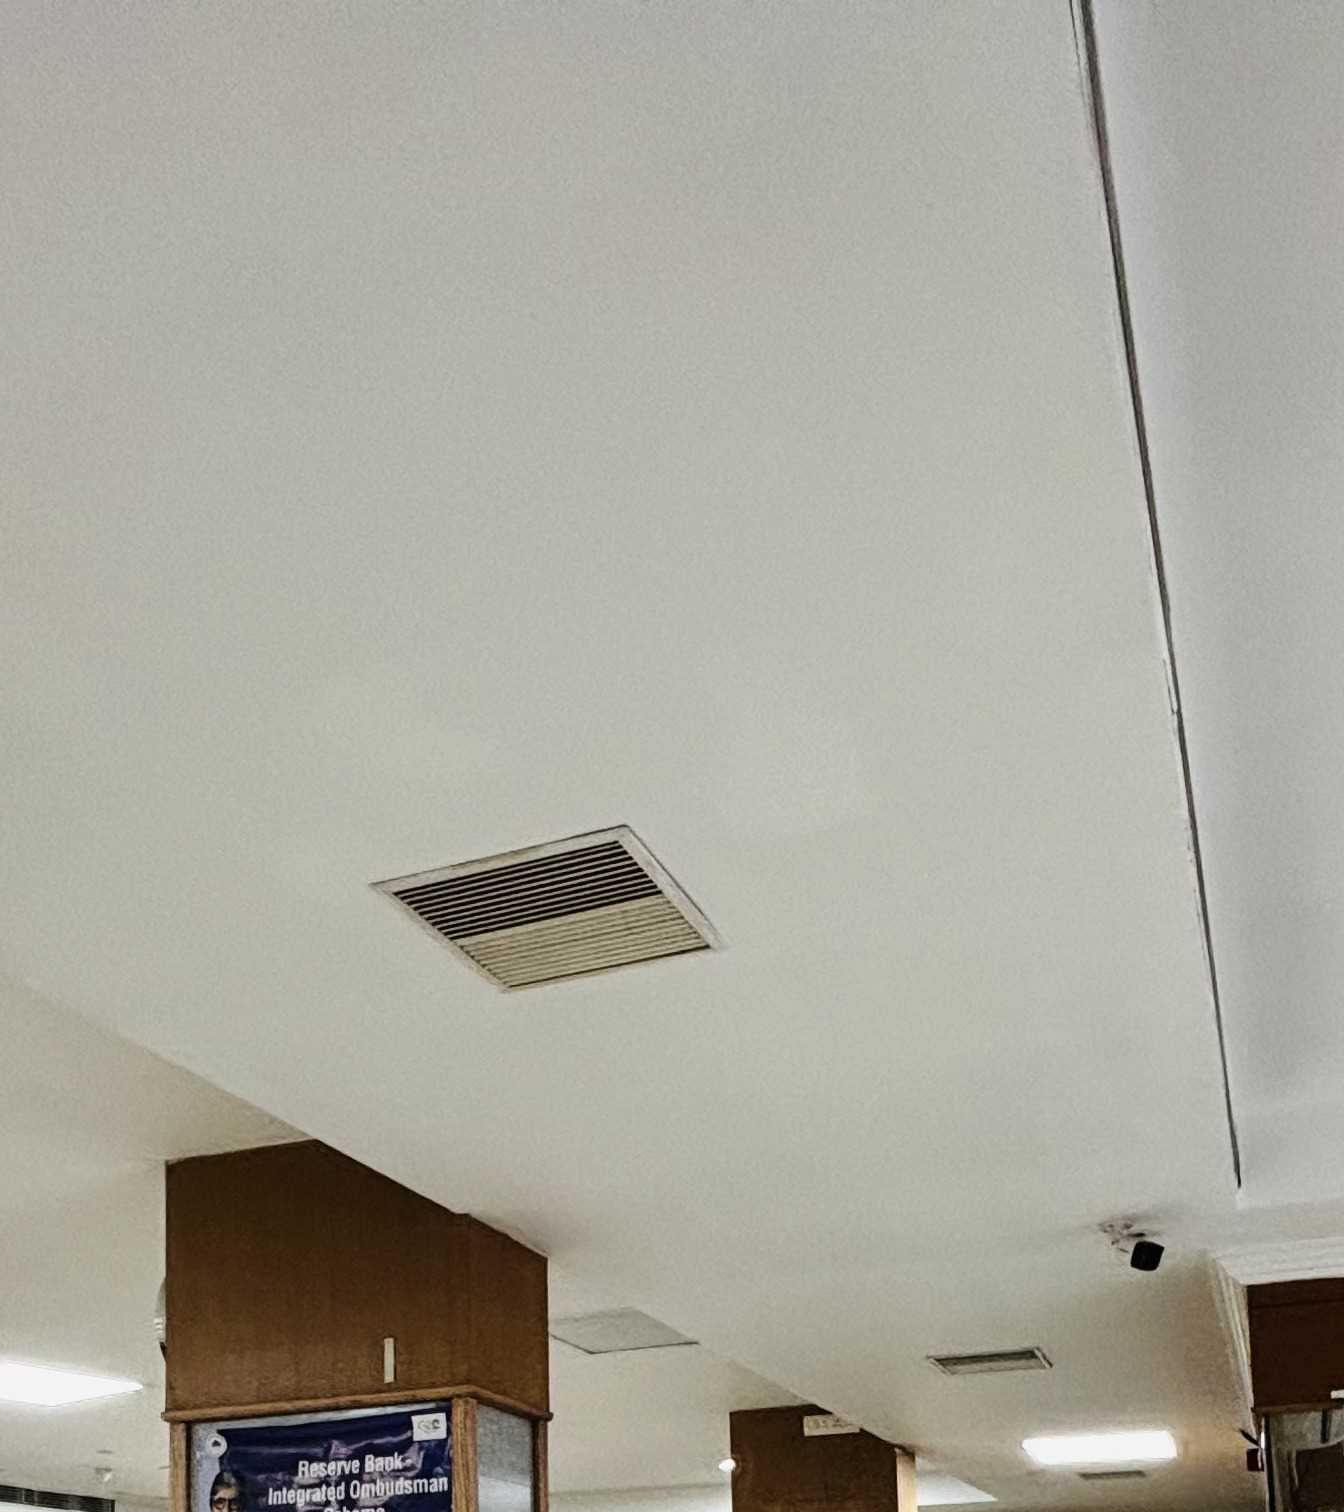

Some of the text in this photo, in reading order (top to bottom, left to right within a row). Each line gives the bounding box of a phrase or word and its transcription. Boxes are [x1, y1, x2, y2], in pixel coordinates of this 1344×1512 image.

[298, 1459, 360, 1479] Reserve
[267, 1476, 449, 1507] Integrated Ombudsman
